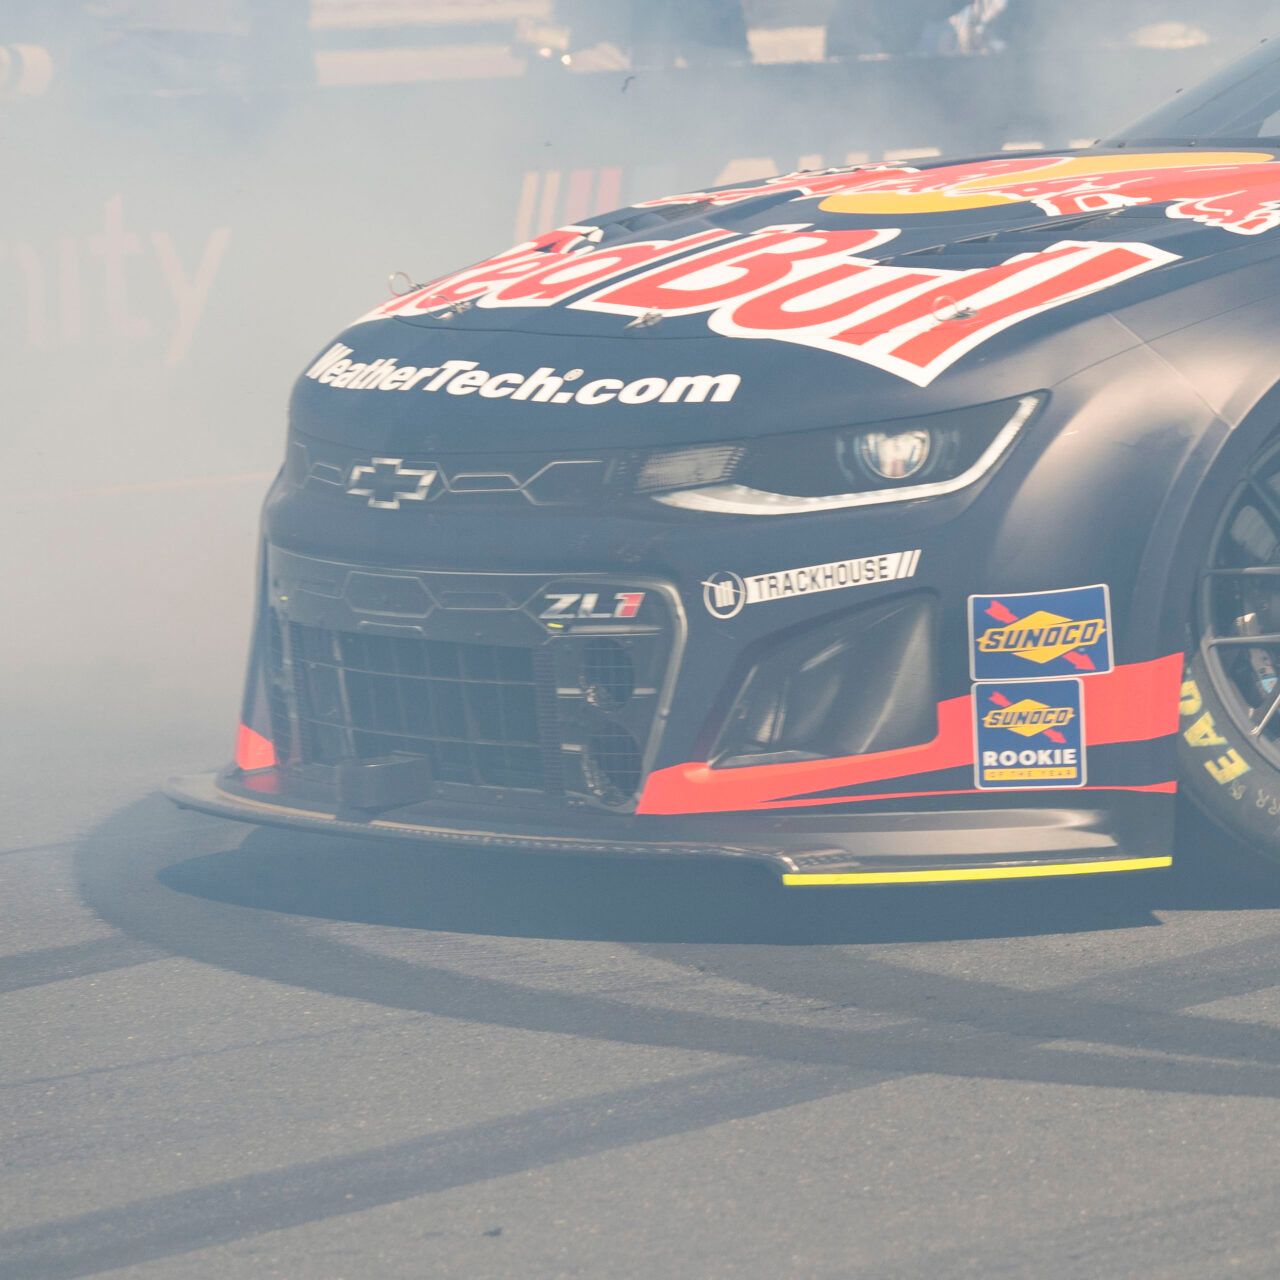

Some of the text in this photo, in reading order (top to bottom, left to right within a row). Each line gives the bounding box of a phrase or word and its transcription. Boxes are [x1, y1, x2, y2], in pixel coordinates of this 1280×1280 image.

[566, 226, 1185, 388] Bull
[305, 342, 742, 406] WeatherTech.com
[754, 556, 889, 600] TRACKHOUSE
[539, 592, 646, 618] ZL1
[983, 620, 1100, 651] SUNOCO
[987, 708, 1070, 726] SUNOCO
[982, 748, 1078, 767] ROOKIE
